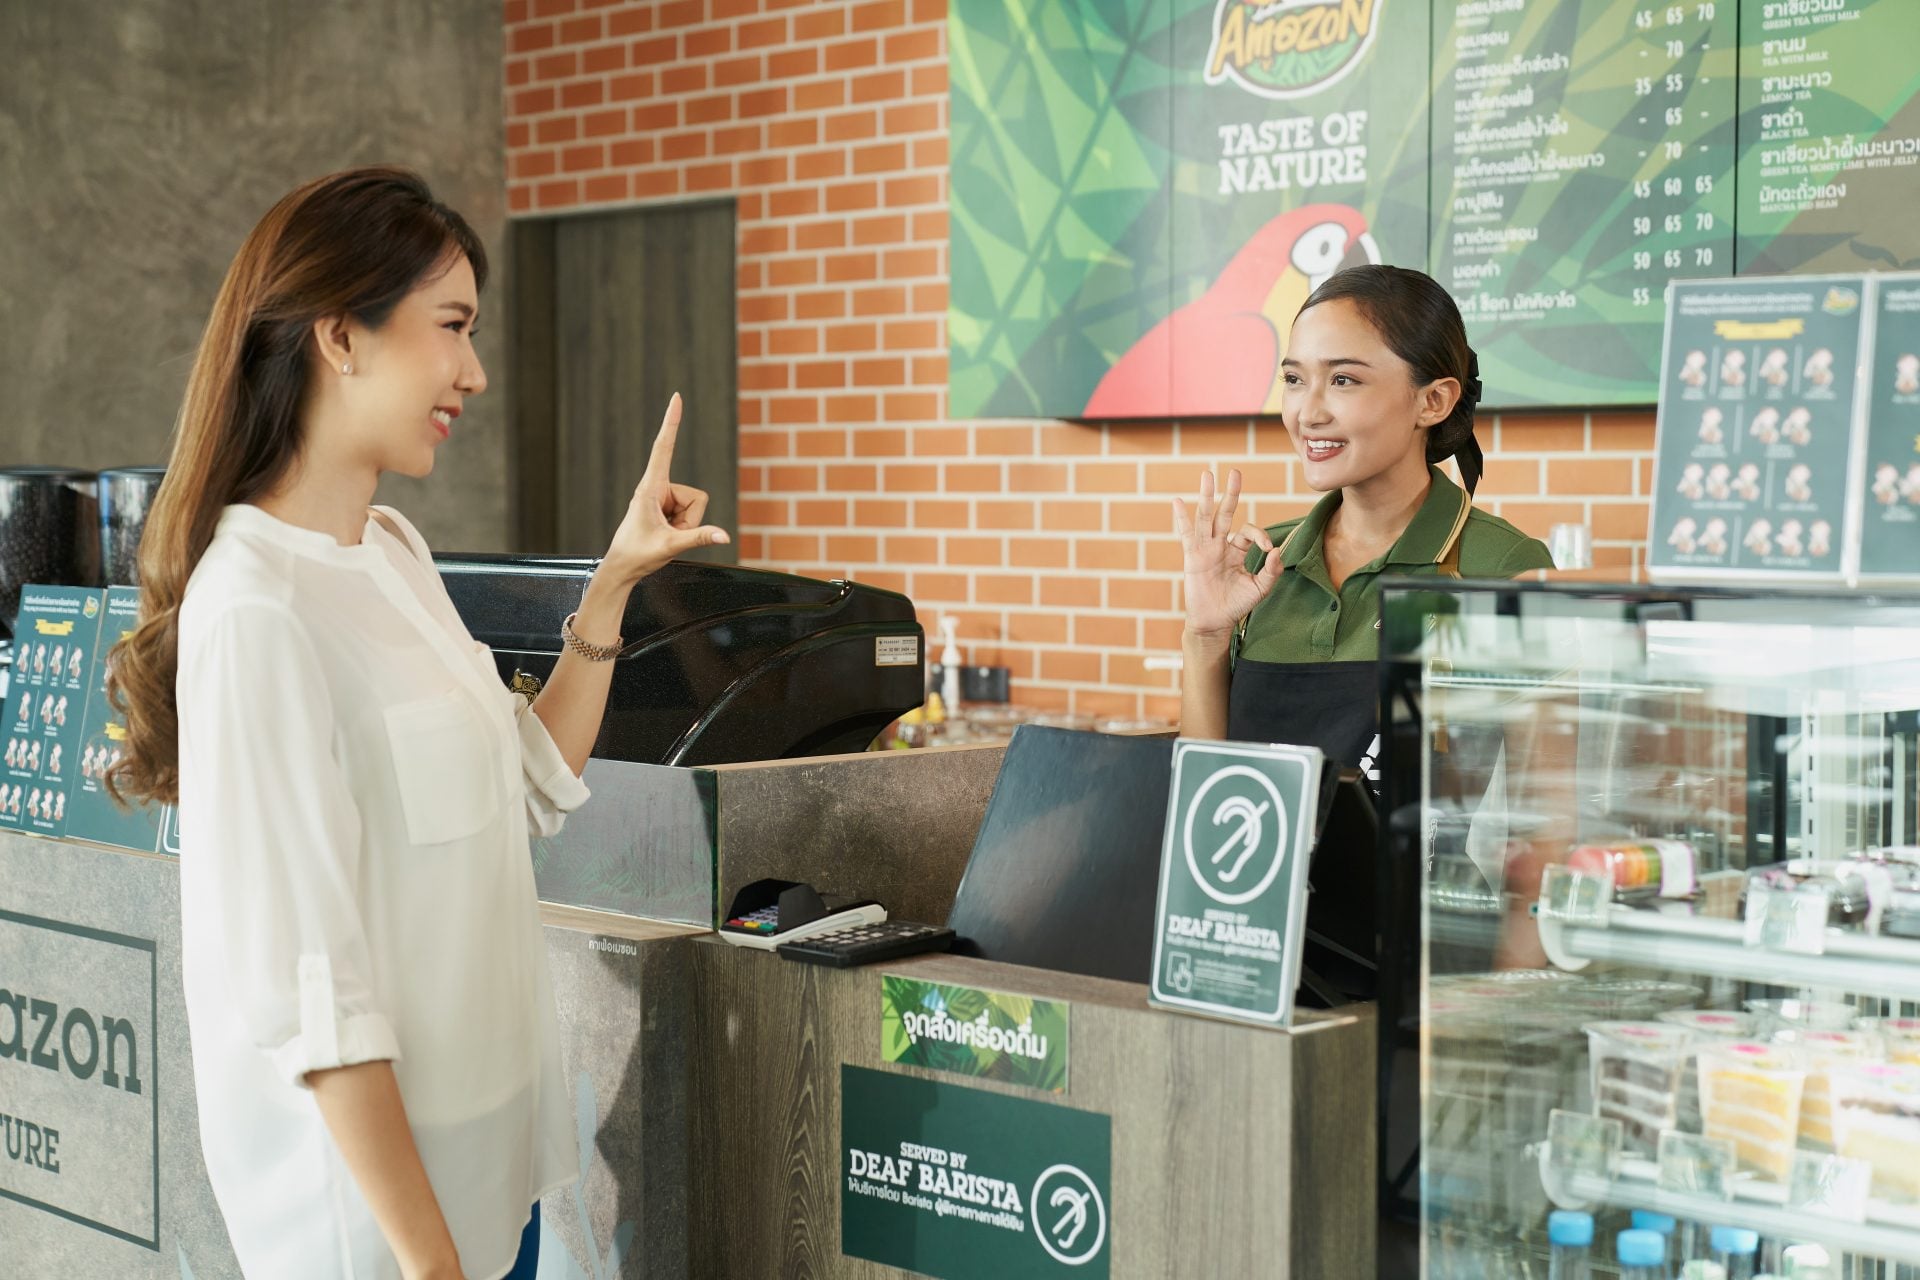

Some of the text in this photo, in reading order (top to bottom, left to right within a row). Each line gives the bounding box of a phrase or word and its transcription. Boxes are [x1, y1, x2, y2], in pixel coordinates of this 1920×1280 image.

[1635, 3, 1715, 28] 45 65 70
[1762, 10, 1860, 30] GREEN TEA WITH MILK
[1666, 40, 1683, 59] 70
[1763, 37, 1806, 55] ชานม
[1762, 51, 1829, 66] TEA WITH MILK
[1635, 73, 1683, 95] 35 55
[1762, 72, 1832, 92] ชามะนาว
[1761, 90, 1812, 103] LEMON TEA
[1665, 107, 1682, 125] 65
[1761, 106, 1803, 129] ชาดำ
[1218, 110, 1368, 156] TASTE OF
[1761, 127, 1809, 141] BLACK TEA
[1665, 141, 1682, 160] 70
[1218, 145, 1367, 195] NATURE
[1791, 164, 1808, 175] TEA
[1867, 157, 1890, 168] WITH
[1892, 154, 1918, 166] JELLY
[1634, 175, 1712, 198] 45 60 65
[1633, 212, 1713, 235] 50 65 70
[1633, 248, 1713, 270] 50 65 70
[1633, 287, 1650, 306] 55
[1168, 914, 1213, 939] DEAF
[1213, 921, 1281, 951] BARISTA
[0, 1113, 60, 1174] URE
[900, 1141, 968, 1170] SERVED BY
[850, 1148, 1023, 1213] DEAF BARISTA
[902, 1191, 933, 1211] Barista
